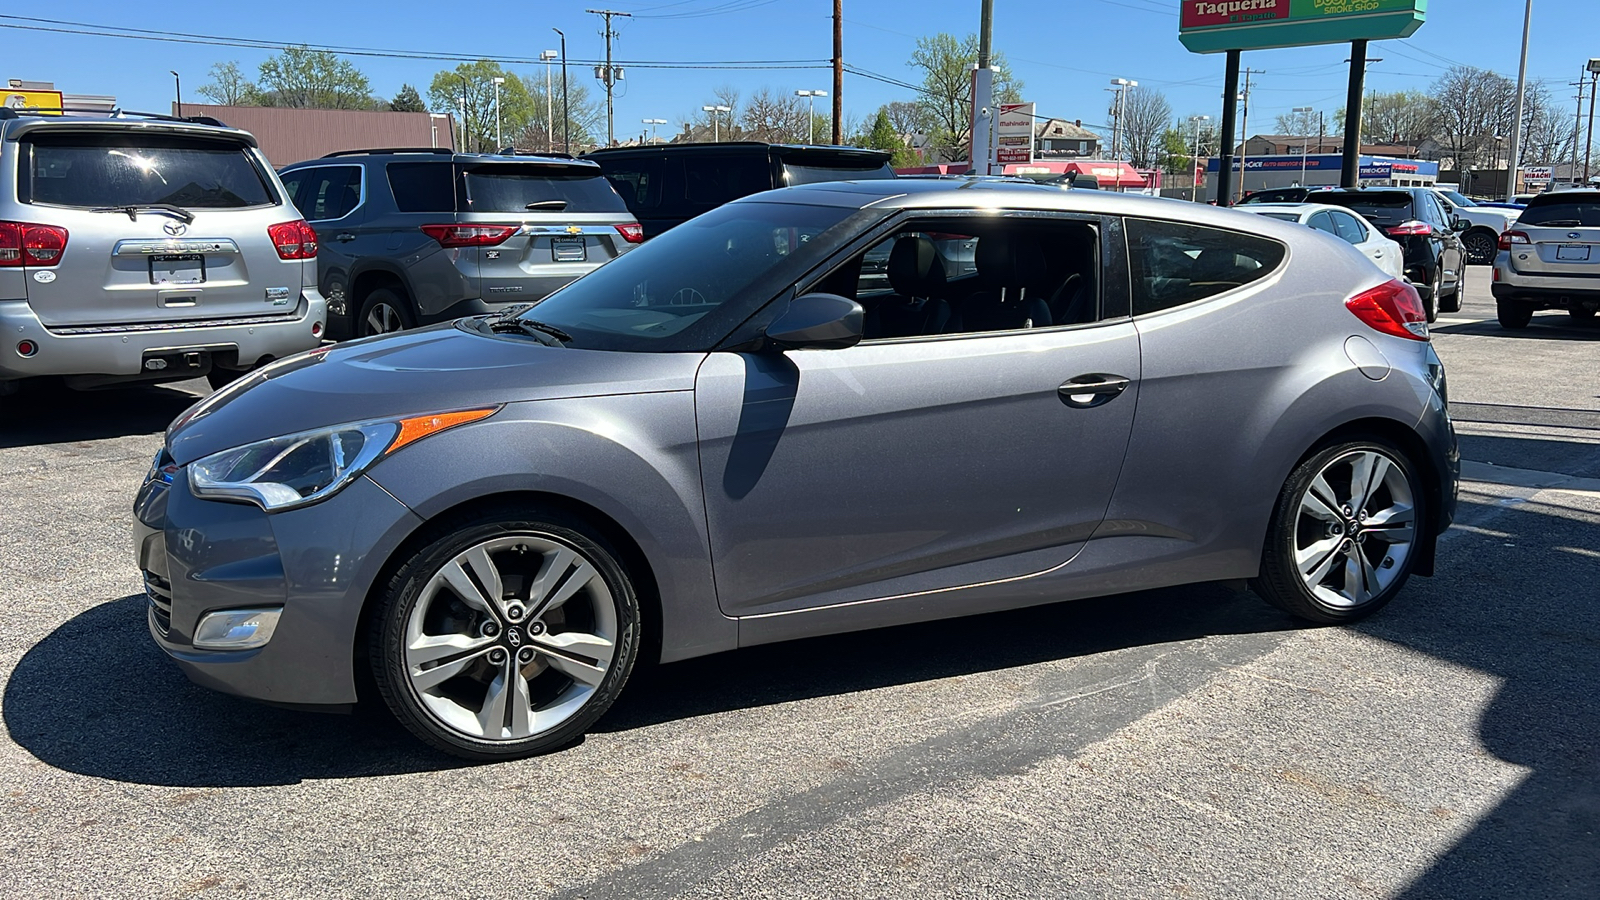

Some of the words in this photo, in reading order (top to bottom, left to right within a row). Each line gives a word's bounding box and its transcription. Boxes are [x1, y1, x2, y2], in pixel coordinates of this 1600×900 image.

[1324, 5, 1354, 14] SMOKE
[1355, 3, 1379, 12] SHOP
[141, 244, 216, 254] SEQUOIA
